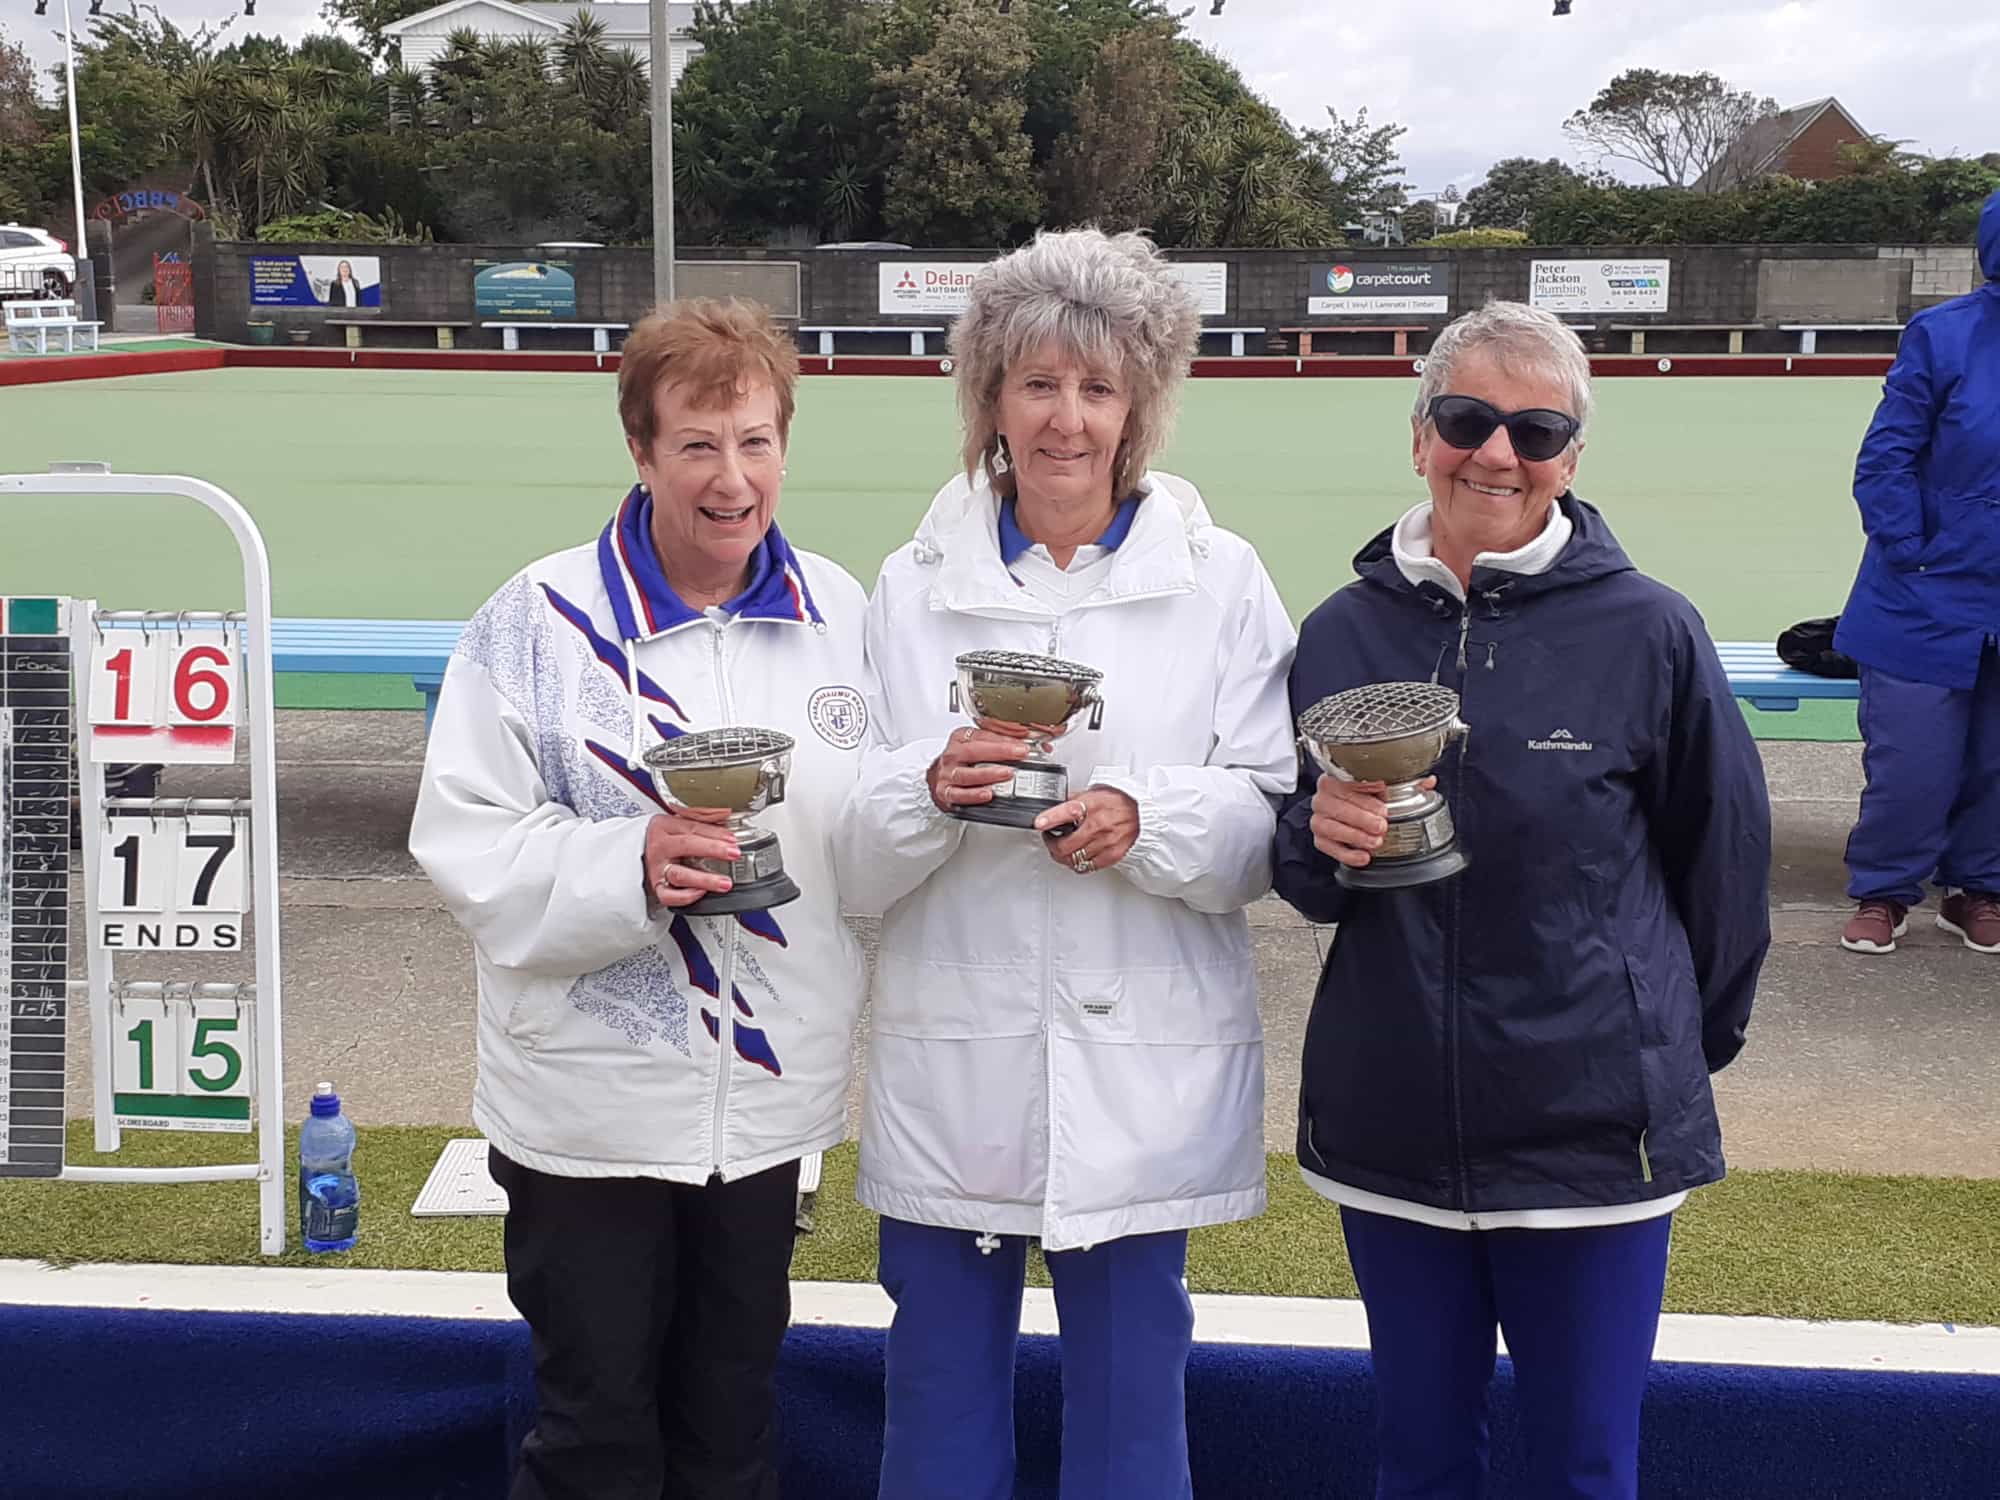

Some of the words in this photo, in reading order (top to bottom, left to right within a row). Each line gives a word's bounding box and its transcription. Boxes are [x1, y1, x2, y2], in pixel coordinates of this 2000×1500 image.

[1535, 264, 1567, 273] Peter
[1356, 273, 1431, 286] carpetcourt
[1535, 274, 1581, 283] Jackson
[1535, 284, 1586, 295] Plumbing
[1527, 740, 1593, 750] Kathmandu
[103, 924, 237, 947] ENDS
